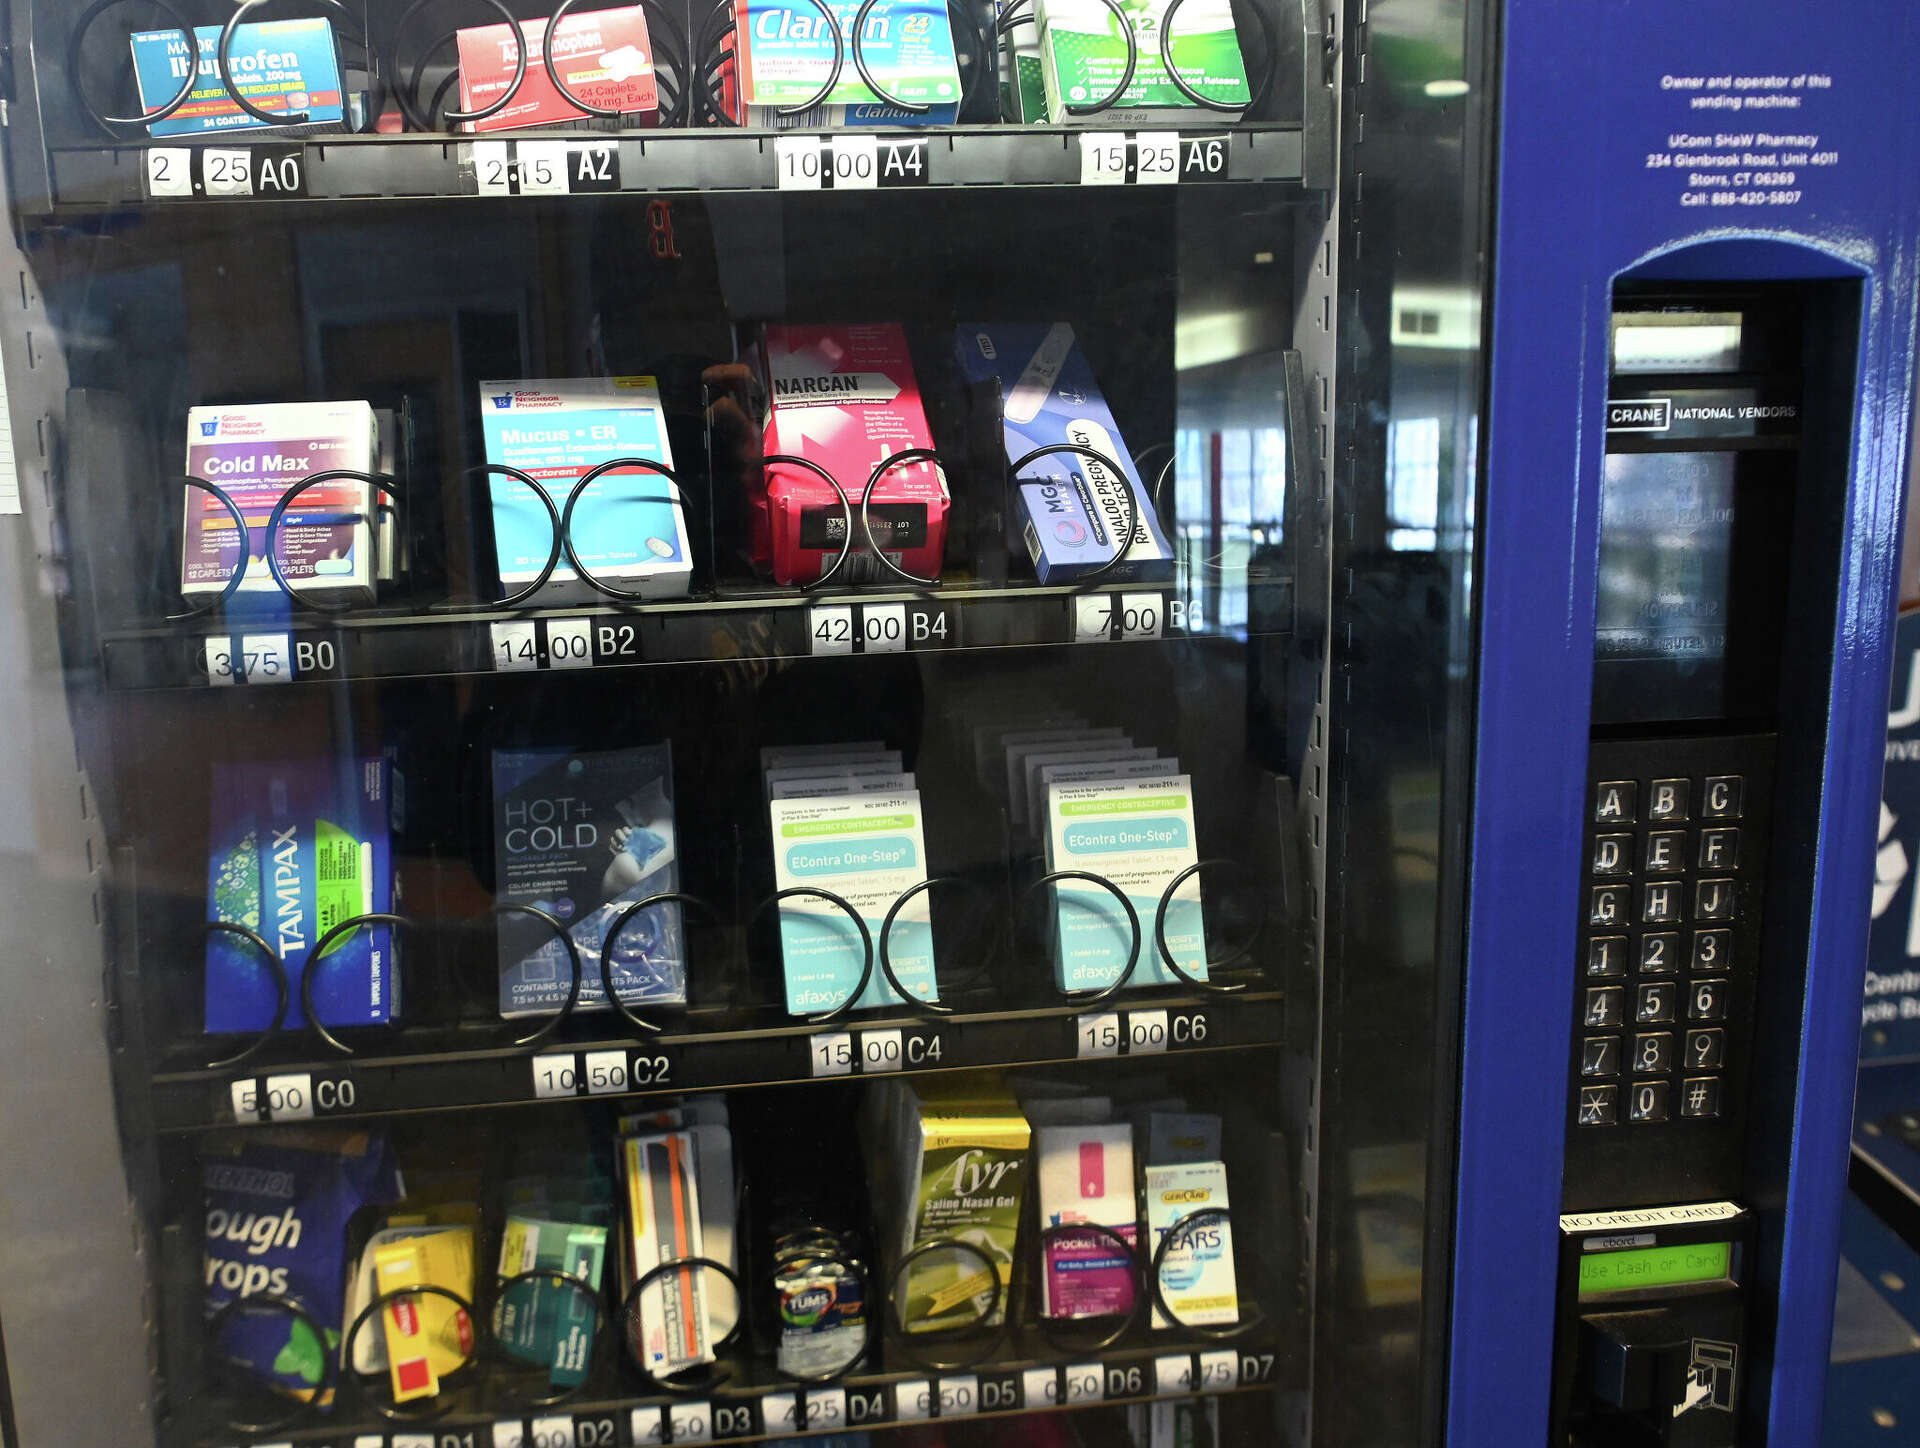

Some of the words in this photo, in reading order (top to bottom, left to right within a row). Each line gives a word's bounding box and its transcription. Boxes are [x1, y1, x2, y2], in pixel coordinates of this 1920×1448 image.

[903, 16, 930, 28] 24
[168, 39, 214, 55] MAOR
[580, 88, 593, 97] 24
[595, 84, 637, 97] Caplets
[1141, 77, 1158, 85] and
[1204, 77, 1240, 85] Release
[1661, 75, 1704, 89] Owner
[1706, 75, 1732, 89] and
[1735, 76, 1788, 90] operator
[1791, 74, 1806, 88] of
[1808, 74, 1832, 88] this
[627, 92, 655, 103] Each
[1690, 96, 1742, 111] vending
[1745, 95, 1801, 108] machine:
[1668, 134, 1712, 148] UConn
[1715, 134, 1753, 148] SHaW
[1756, 133, 1819, 149] Pharmacy
[578, 148, 612, 180] A2
[784, 152, 872, 178] 10.00
[884, 144, 923, 177] A4
[1092, 148, 1175, 172] 15.25
[1185, 141, 1223, 173] A6
[1646, 155, 1671, 168] 234
[1674, 153, 1740, 168] Glenbrook
[1743, 153, 1780, 167] Road,
[1782, 152, 1808, 166] Unit
[1811, 152, 1838, 165] 4011
[259, 157, 299, 191] A0
[1689, 173, 1731, 187] Storrs,
[1733, 173, 1751, 186] CT
[1753, 172, 1795, 186] 06269
[1681, 191, 1709, 206] Call:
[1711, 190, 1802, 206] 888-420-5807
[774, 376, 859, 395] NARCAN
[1611, 408, 1662, 422] CRANE
[1674, 406, 1734, 420] NATIONAL
[1738, 405, 1796, 419] VENDORS
[502, 429, 570, 445] Mucus
[591, 425, 618, 440] ER
[204, 456, 254, 475] Cold
[262, 455, 309, 472] Max
[510, 468, 578, 479] pectorant
[1072, 430, 1112, 496] PREGNCY
[1052, 472, 1076, 513] HEALTH
[1110, 479, 1128, 506] TEST
[1101, 497, 1129, 543] ANALOG
[199, 568, 232, 577] CAPLETS
[281, 565, 314, 575] CAPLETS
[815, 618, 901, 643] 42.00
[912, 612, 948, 641] B4
[1098, 609, 1156, 632] 7.00
[500, 635, 587, 663] 14.00
[599, 625, 637, 656] B2
[215, 653, 279, 676] 3.75
[296, 640, 335, 671] B0
[1071, 803, 1116, 813] EMERGENCY
[1118, 798, 1176, 810] CONTRACEPTIVE
[1601, 788, 1621, 817] A
[1657, 785, 1675, 814] B
[1711, 782, 1729, 810] C
[506, 823, 597, 853] COLD
[793, 822, 842, 834] EMERGENCY
[842, 817, 904, 831] CONTRACEPTIVE
[1069, 834, 1117, 847] EContra
[1655, 837, 1671, 865] E
[1707, 834, 1724, 862] F
[792, 855, 841, 869] EContra
[1601, 840, 1619, 869] D
[1131, 870, 1161, 880] pregnancy
[272, 825, 306, 959] TAMPAX
[857, 891, 889, 901] pregnancy
[1651, 888, 1669, 917] H
[1704, 885, 1719, 913] J
[1599, 892, 1615, 920] G
[1598, 942, 1608, 969] 1
[1648, 938, 1665, 966] 2
[1701, 935, 1717, 962] 3
[512, 982, 558, 993] CONTAINS
[627, 975, 650, 985] PACK
[1072, 964, 1121, 981] afaxys
[795, 989, 847, 1005] afaxys
[1592, 993, 1608, 1019] 4
[1645, 988, 1661, 1016] 5
[1697, 984, 1713, 1012] 6
[1086, 1023, 1164, 1049] 15.00
[1174, 1014, 1208, 1043] C6
[819, 1040, 898, 1068] 15.00
[908, 1034, 942, 1064] C4
[1594, 1042, 1609, 1068] 7
[1642, 1038, 1659, 1065] 8
[1695, 1034, 1713, 1062] 9
[542, 1065, 625, 1090] 10.50
[634, 1056, 670, 1084] C2
[241, 1089, 304, 1113] 5.00
[317, 1079, 355, 1109] C0
[1639, 1086, 1655, 1115] 0
[1688, 1082, 1708, 1110] #
[931, 1149, 1019, 1197] Ayr
[925, 1198, 960, 1210] Saline
[962, 1197, 994, 1208] Nasal
[997, 1196, 1015, 1208] Gel
[1561, 1216, 1593, 1228] NO
[1596, 1210, 1664, 1225] CREDIT
[1670, 1204, 1738, 1219] CARDS
[206, 1206, 302, 1255] ough
[1053, 1238, 1097, 1251] Pocket
[204, 1256, 289, 1299] rops
[1581, 1264, 1608, 1280] Use
[1616, 1259, 1651, 1276] Cash
[1659, 1259, 1677, 1273] or
[1685, 1253, 1721, 1269] Card
[790, 1293, 829, 1310] TUMS
[1108, 1367, 1142, 1392] D6
[1243, 1355, 1275, 1378] D7
[982, 1382, 1016, 1406] D5
[716, 1406, 750, 1434] D3
[784, 1399, 839, 1426] 4.25
[851, 1396, 884, 1421] D4
[578, 1419, 614, 1447] D2
